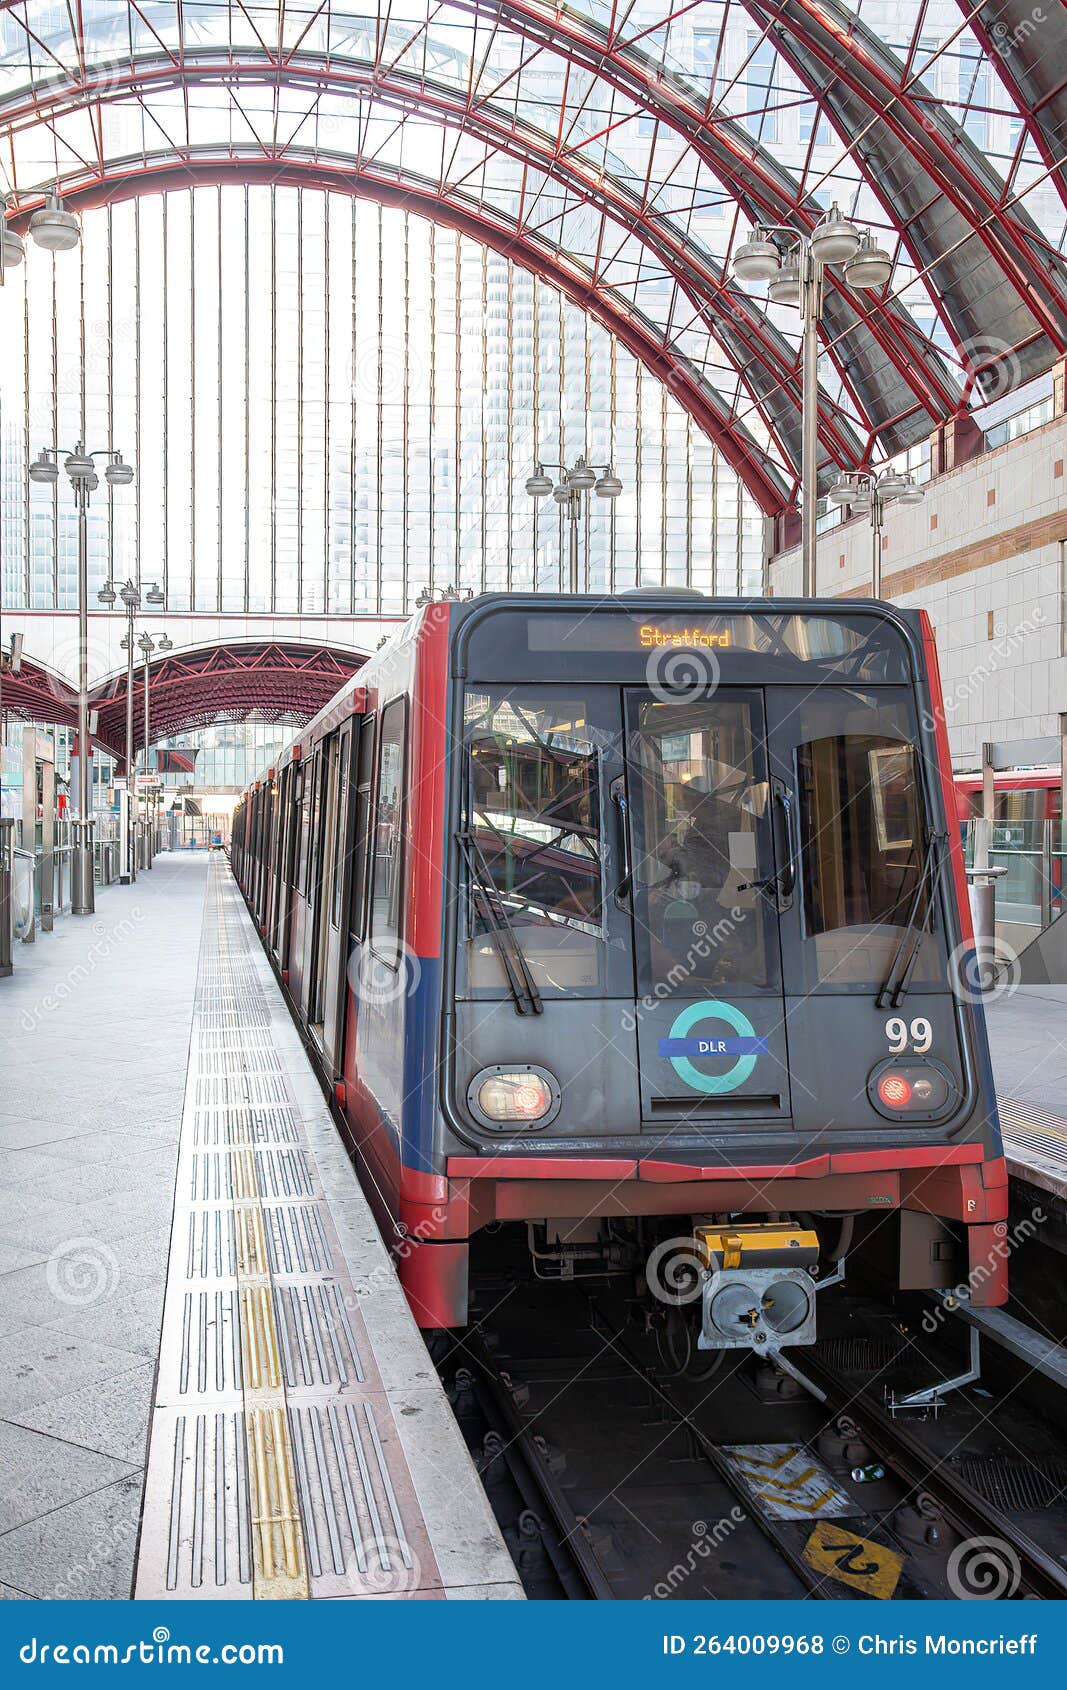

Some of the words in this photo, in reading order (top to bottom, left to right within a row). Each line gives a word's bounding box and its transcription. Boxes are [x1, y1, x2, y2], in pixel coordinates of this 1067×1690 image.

[640, 625, 731, 647] Stratford
[699, 1041, 727, 1053] DLR
[885, 1017, 933, 1053] 99
[821, 1544, 880, 1576] 2
